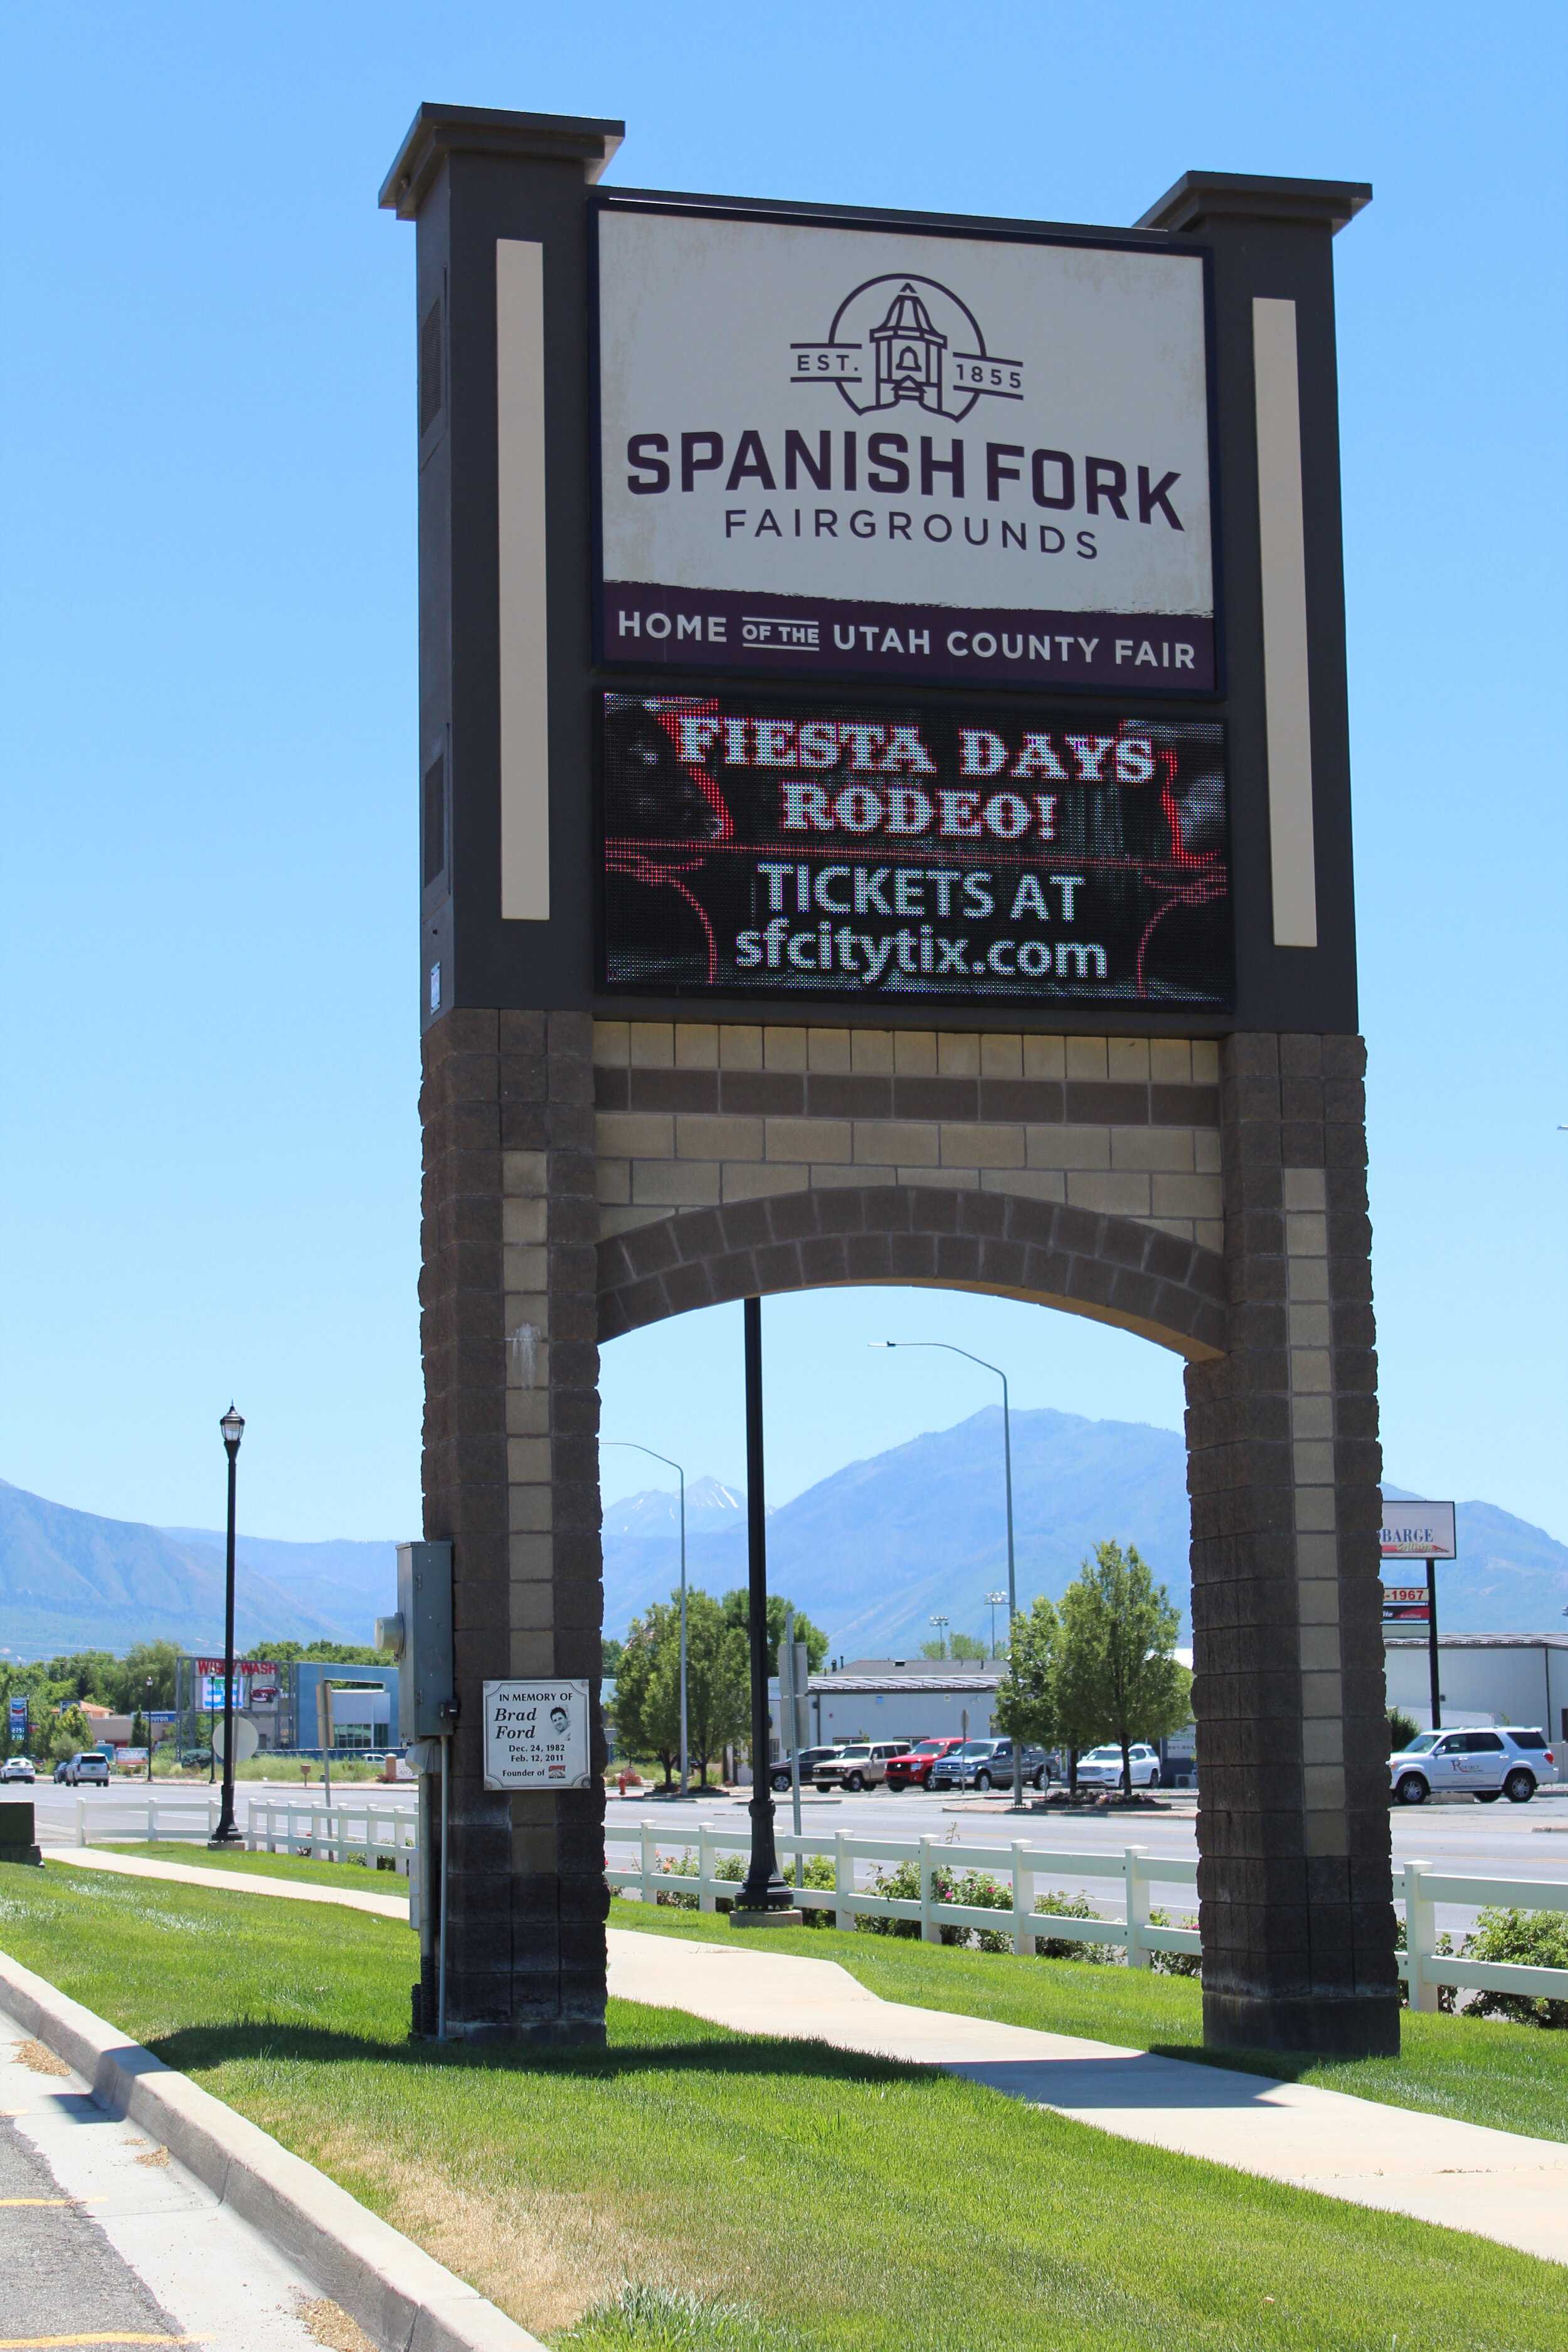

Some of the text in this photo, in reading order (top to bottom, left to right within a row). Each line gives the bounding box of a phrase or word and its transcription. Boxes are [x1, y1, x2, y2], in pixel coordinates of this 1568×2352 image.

[797, 354, 859, 372] EST.
[956, 363, 1022, 390] 1855
[627, 430, 1185, 532] SPANISH FORK
[725, 509, 1099, 560] FAIRGROUNDS
[618, 611, 1195, 670] HOME OF THE UTAH COUNTY FAIR
[675, 715, 1155, 785] FIESTA DAYS
[780, 781, 1058, 840] RODEO!
[757, 862, 1086, 923] TICKETS AT
[735, 918, 1108, 983] sfcitytix.com
[1379, 1528, 1434, 1543] BARGE
[1384, 1590, 1424, 1601] -1967
[240, 1661, 278, 1676] WASH
[499, 1693, 573, 1702] IN MEMORY OF
[494, 1707, 537, 1722] Brad
[495, 1725, 536, 1739] Ford
[530, 1744, 544, 1753] 24,
[546, 1744, 565, 1752] 1982
[511, 1754, 528, 1762] Feb.
[531, 1754, 543, 1763] 12,
[502, 1769, 535, 1777] Founder
